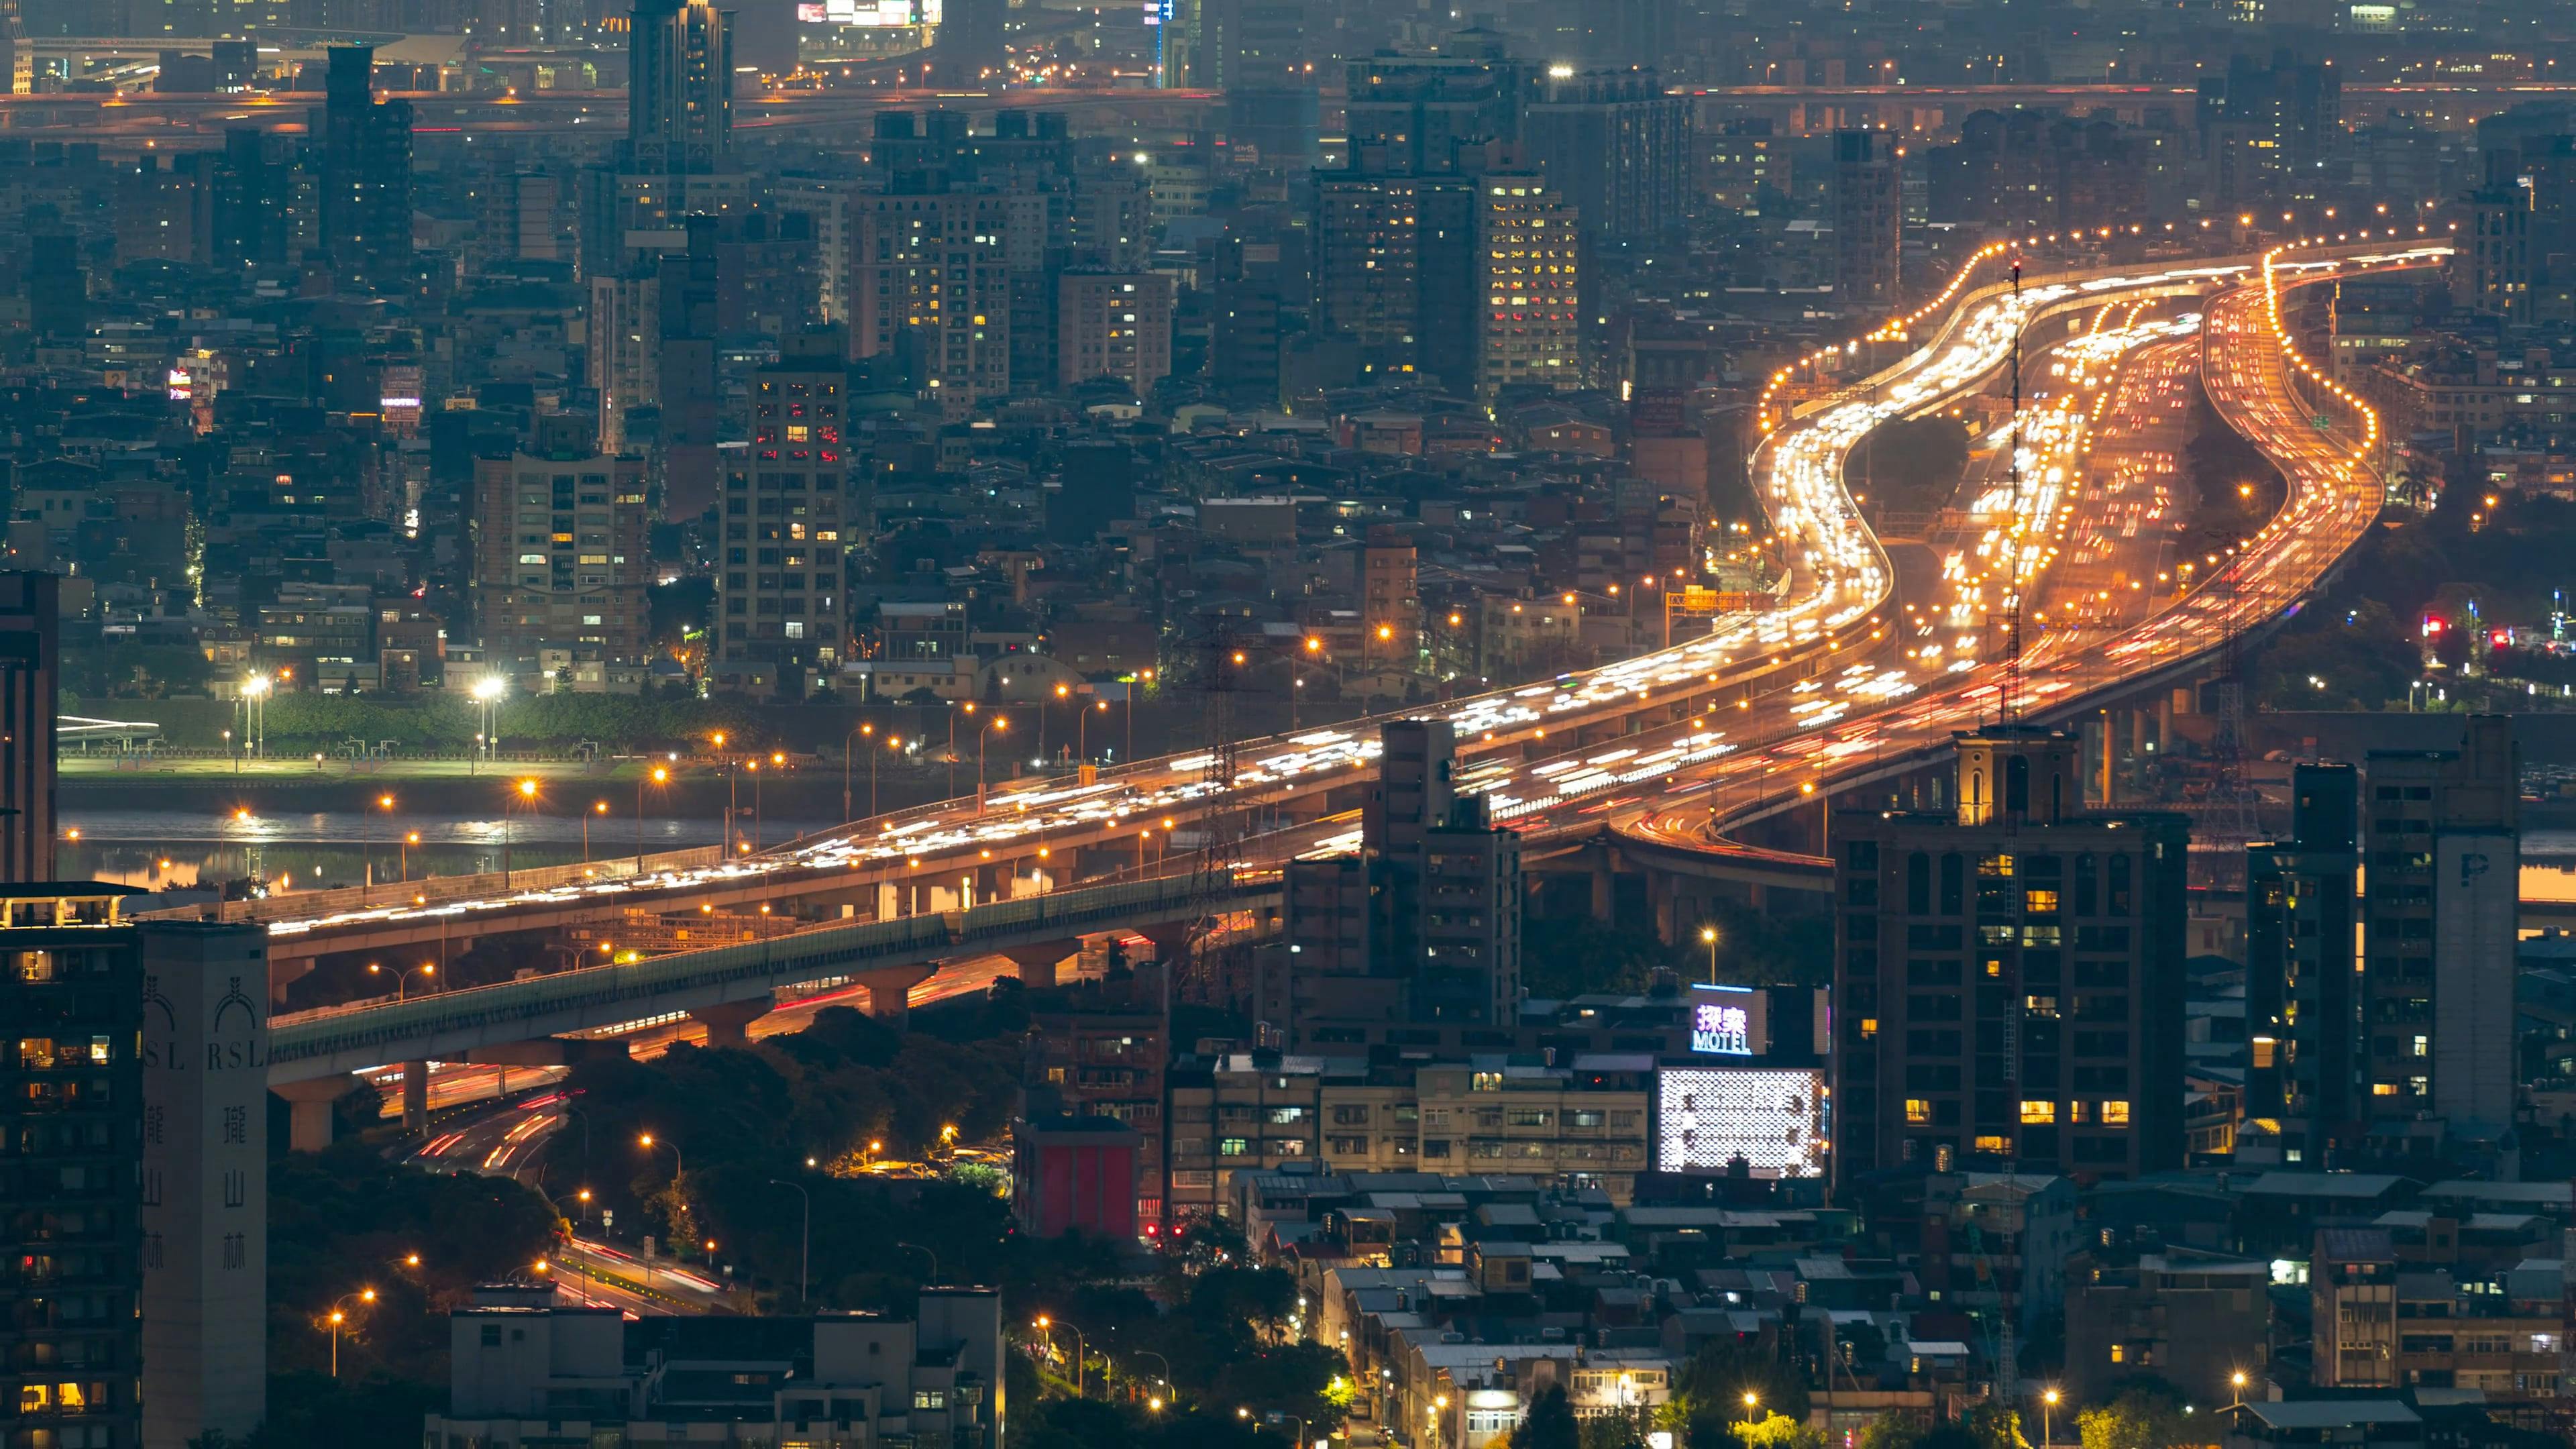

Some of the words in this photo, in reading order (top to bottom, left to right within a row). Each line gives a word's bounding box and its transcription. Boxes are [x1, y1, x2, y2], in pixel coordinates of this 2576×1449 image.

[207, 1040, 264, 1070] RSL
[1693, 1030, 1750, 1052] MOTEL
[223, 1106, 246, 1271] 瓏山林
